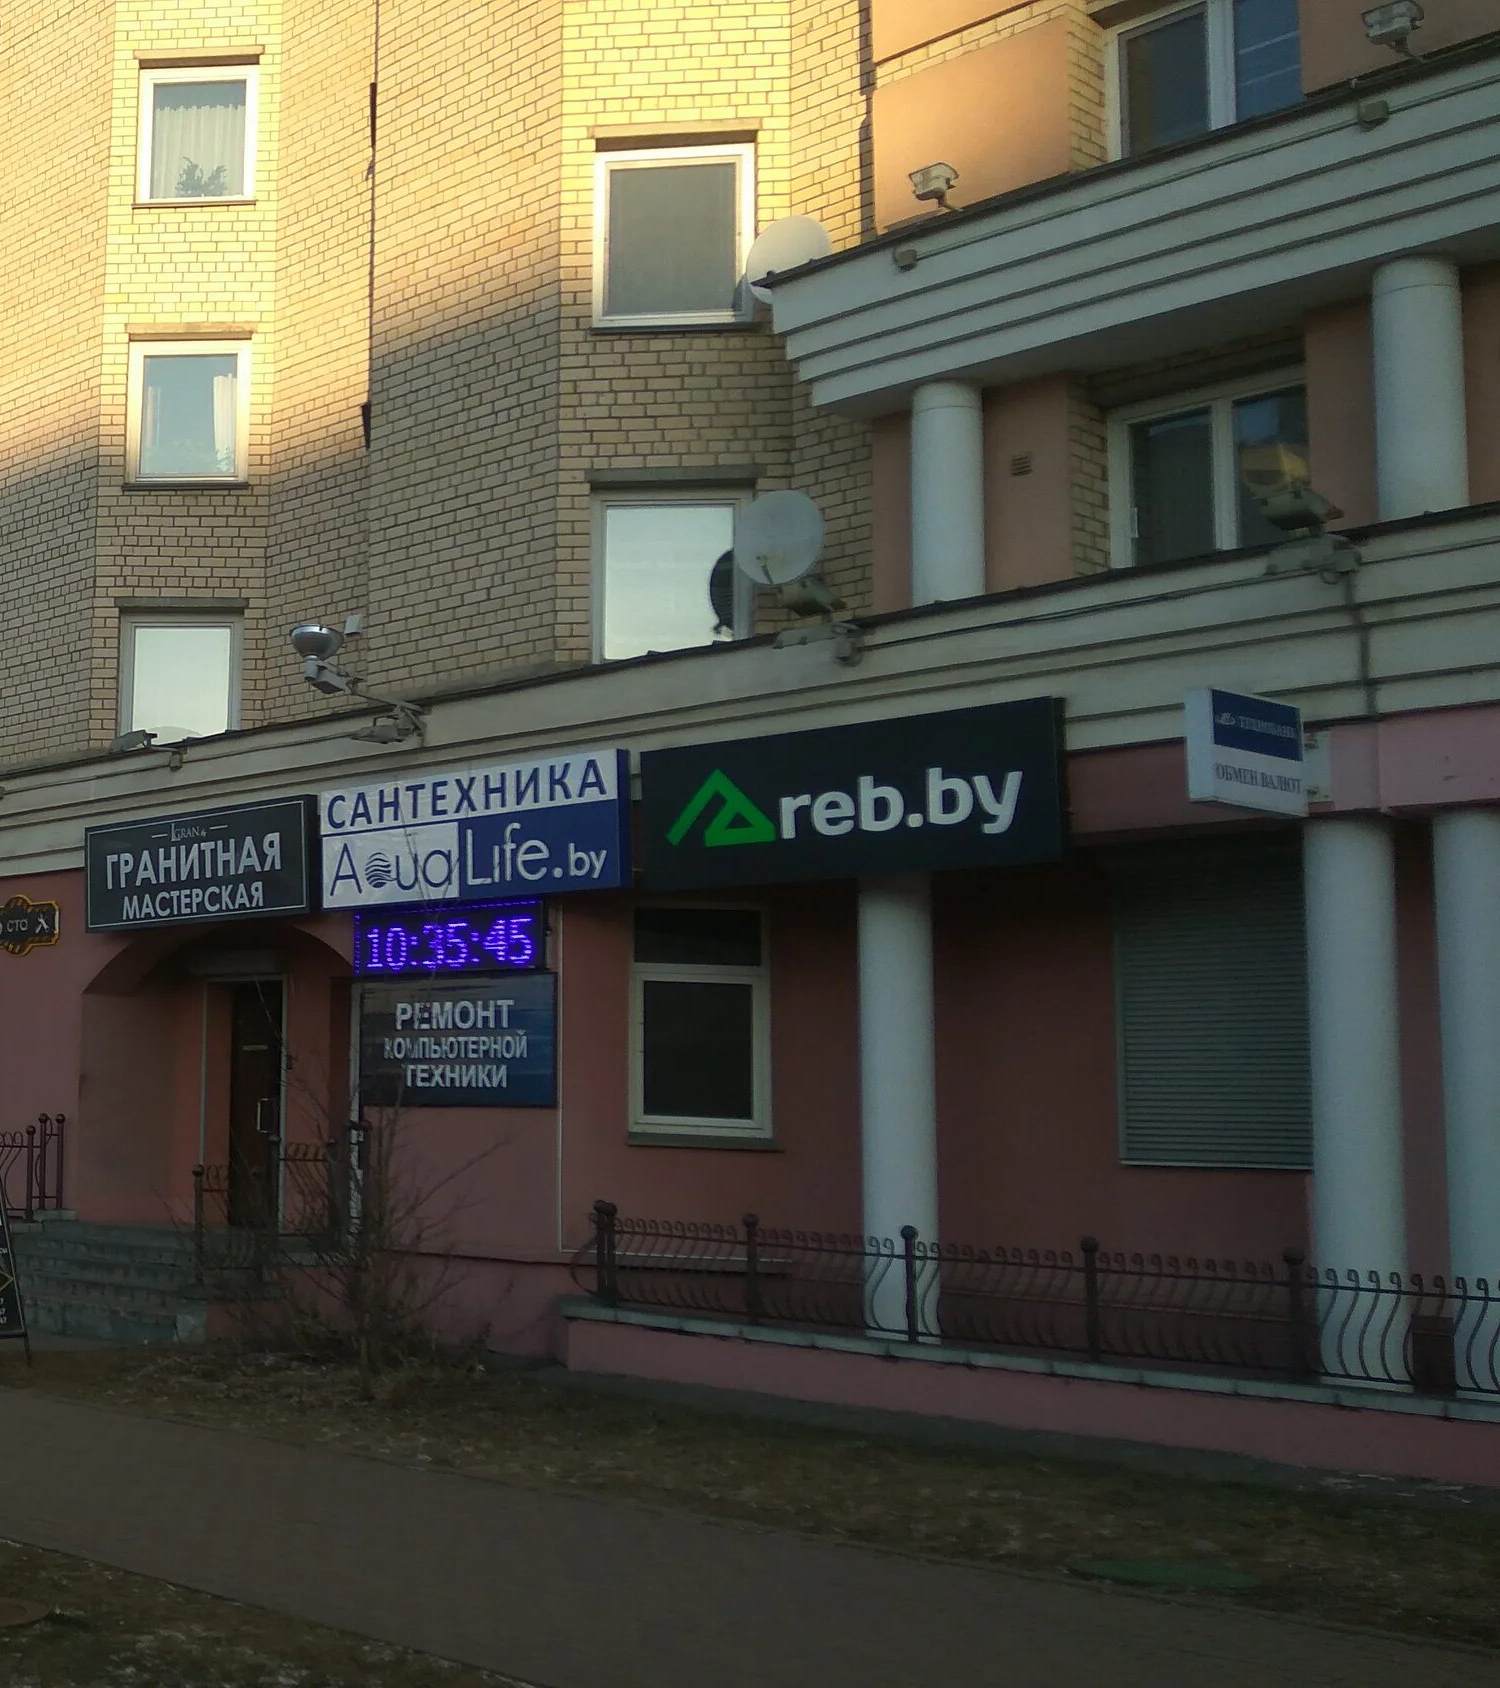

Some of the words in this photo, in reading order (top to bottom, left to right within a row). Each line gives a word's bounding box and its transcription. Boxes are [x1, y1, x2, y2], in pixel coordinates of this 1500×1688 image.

[327, 759, 607, 829] САНТЕХНИКА
[1214, 762, 1258, 788] ОБМЕН
[1259, 771, 1302, 795] ВАЛЮТ
[778, 767, 1023, 840] reb.by
[106, 832, 282, 890] ГРАНИТНАЯ
[122, 881, 264, 920] МАСТЕРСКАЯ
[366, 918, 533, 971] 10:35:45
[395, 999, 515, 1030] РЕМОНТ
[383, 1029, 528, 1060] КОМПЬЮТЕРНОЙ
[403, 1064, 508, 1088] ТЕХНИКИ
